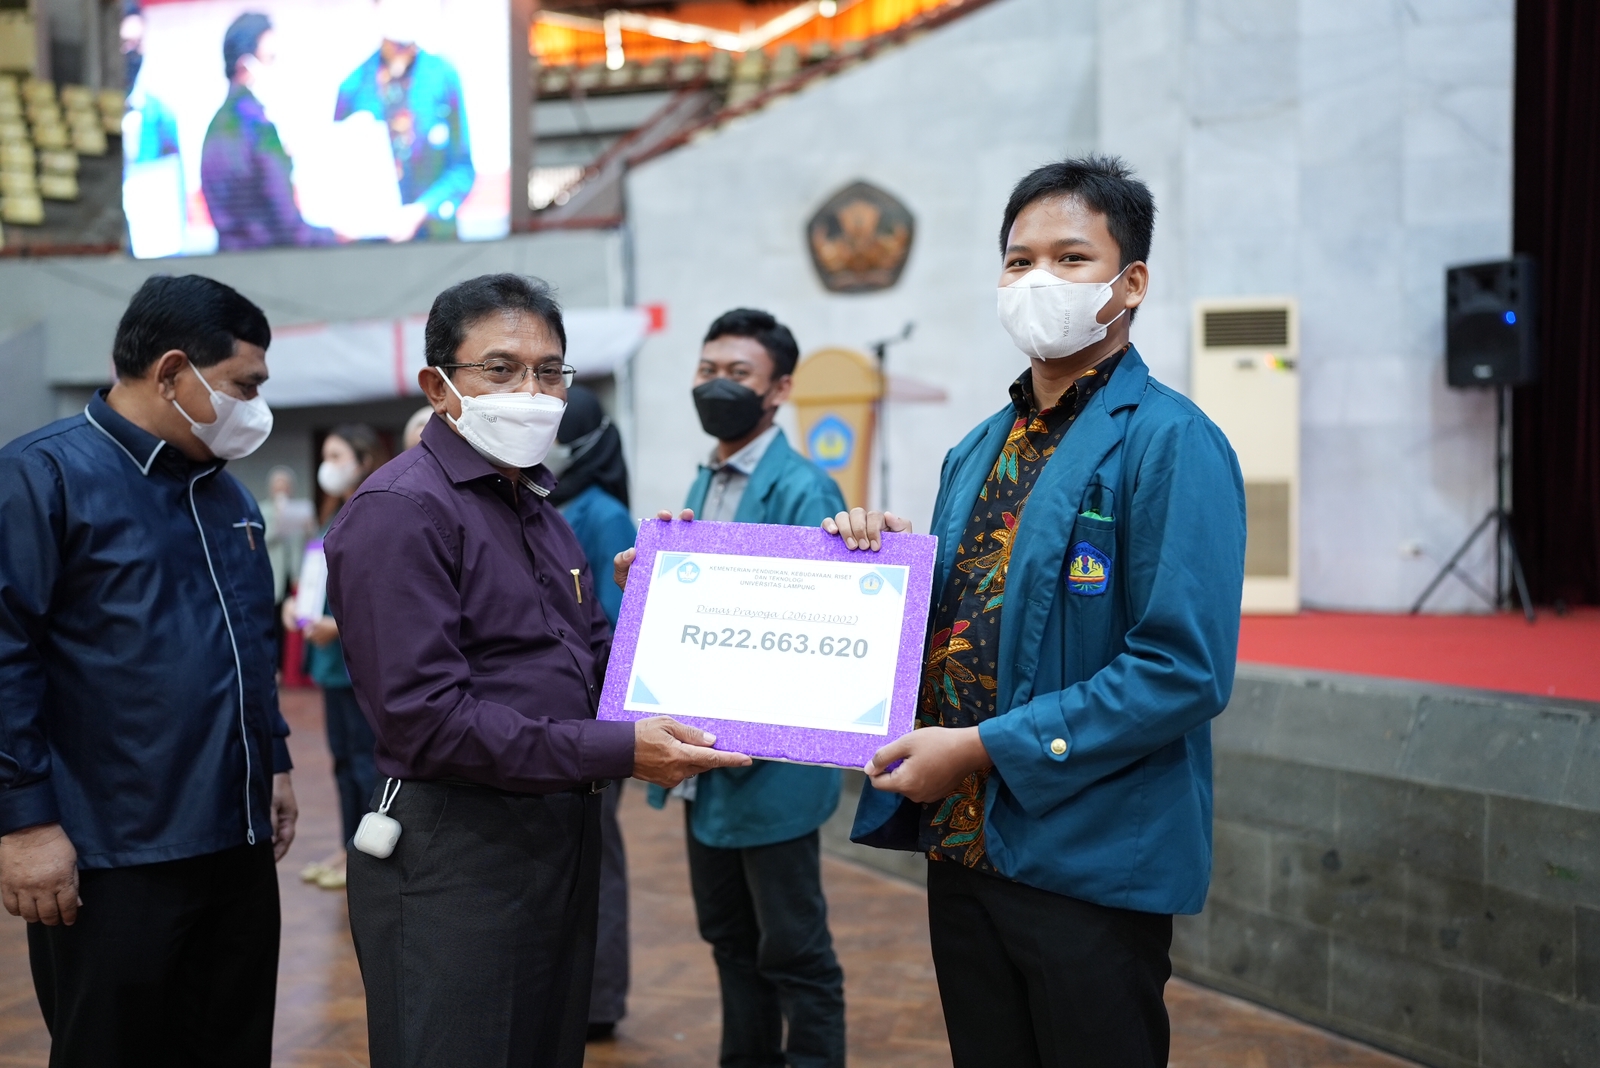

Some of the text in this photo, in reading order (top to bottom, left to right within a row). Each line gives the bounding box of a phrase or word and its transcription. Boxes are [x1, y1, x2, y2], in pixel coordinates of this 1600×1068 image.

[739, 580, 816, 591] UNIVERSITAS LAMPUNG
[769, 575, 804, 583] TEKNOLOGI
[696, 604, 859, 625] Dimas Prayoga (2061031002)
[680, 624, 869, 659] Rp22.663.620
